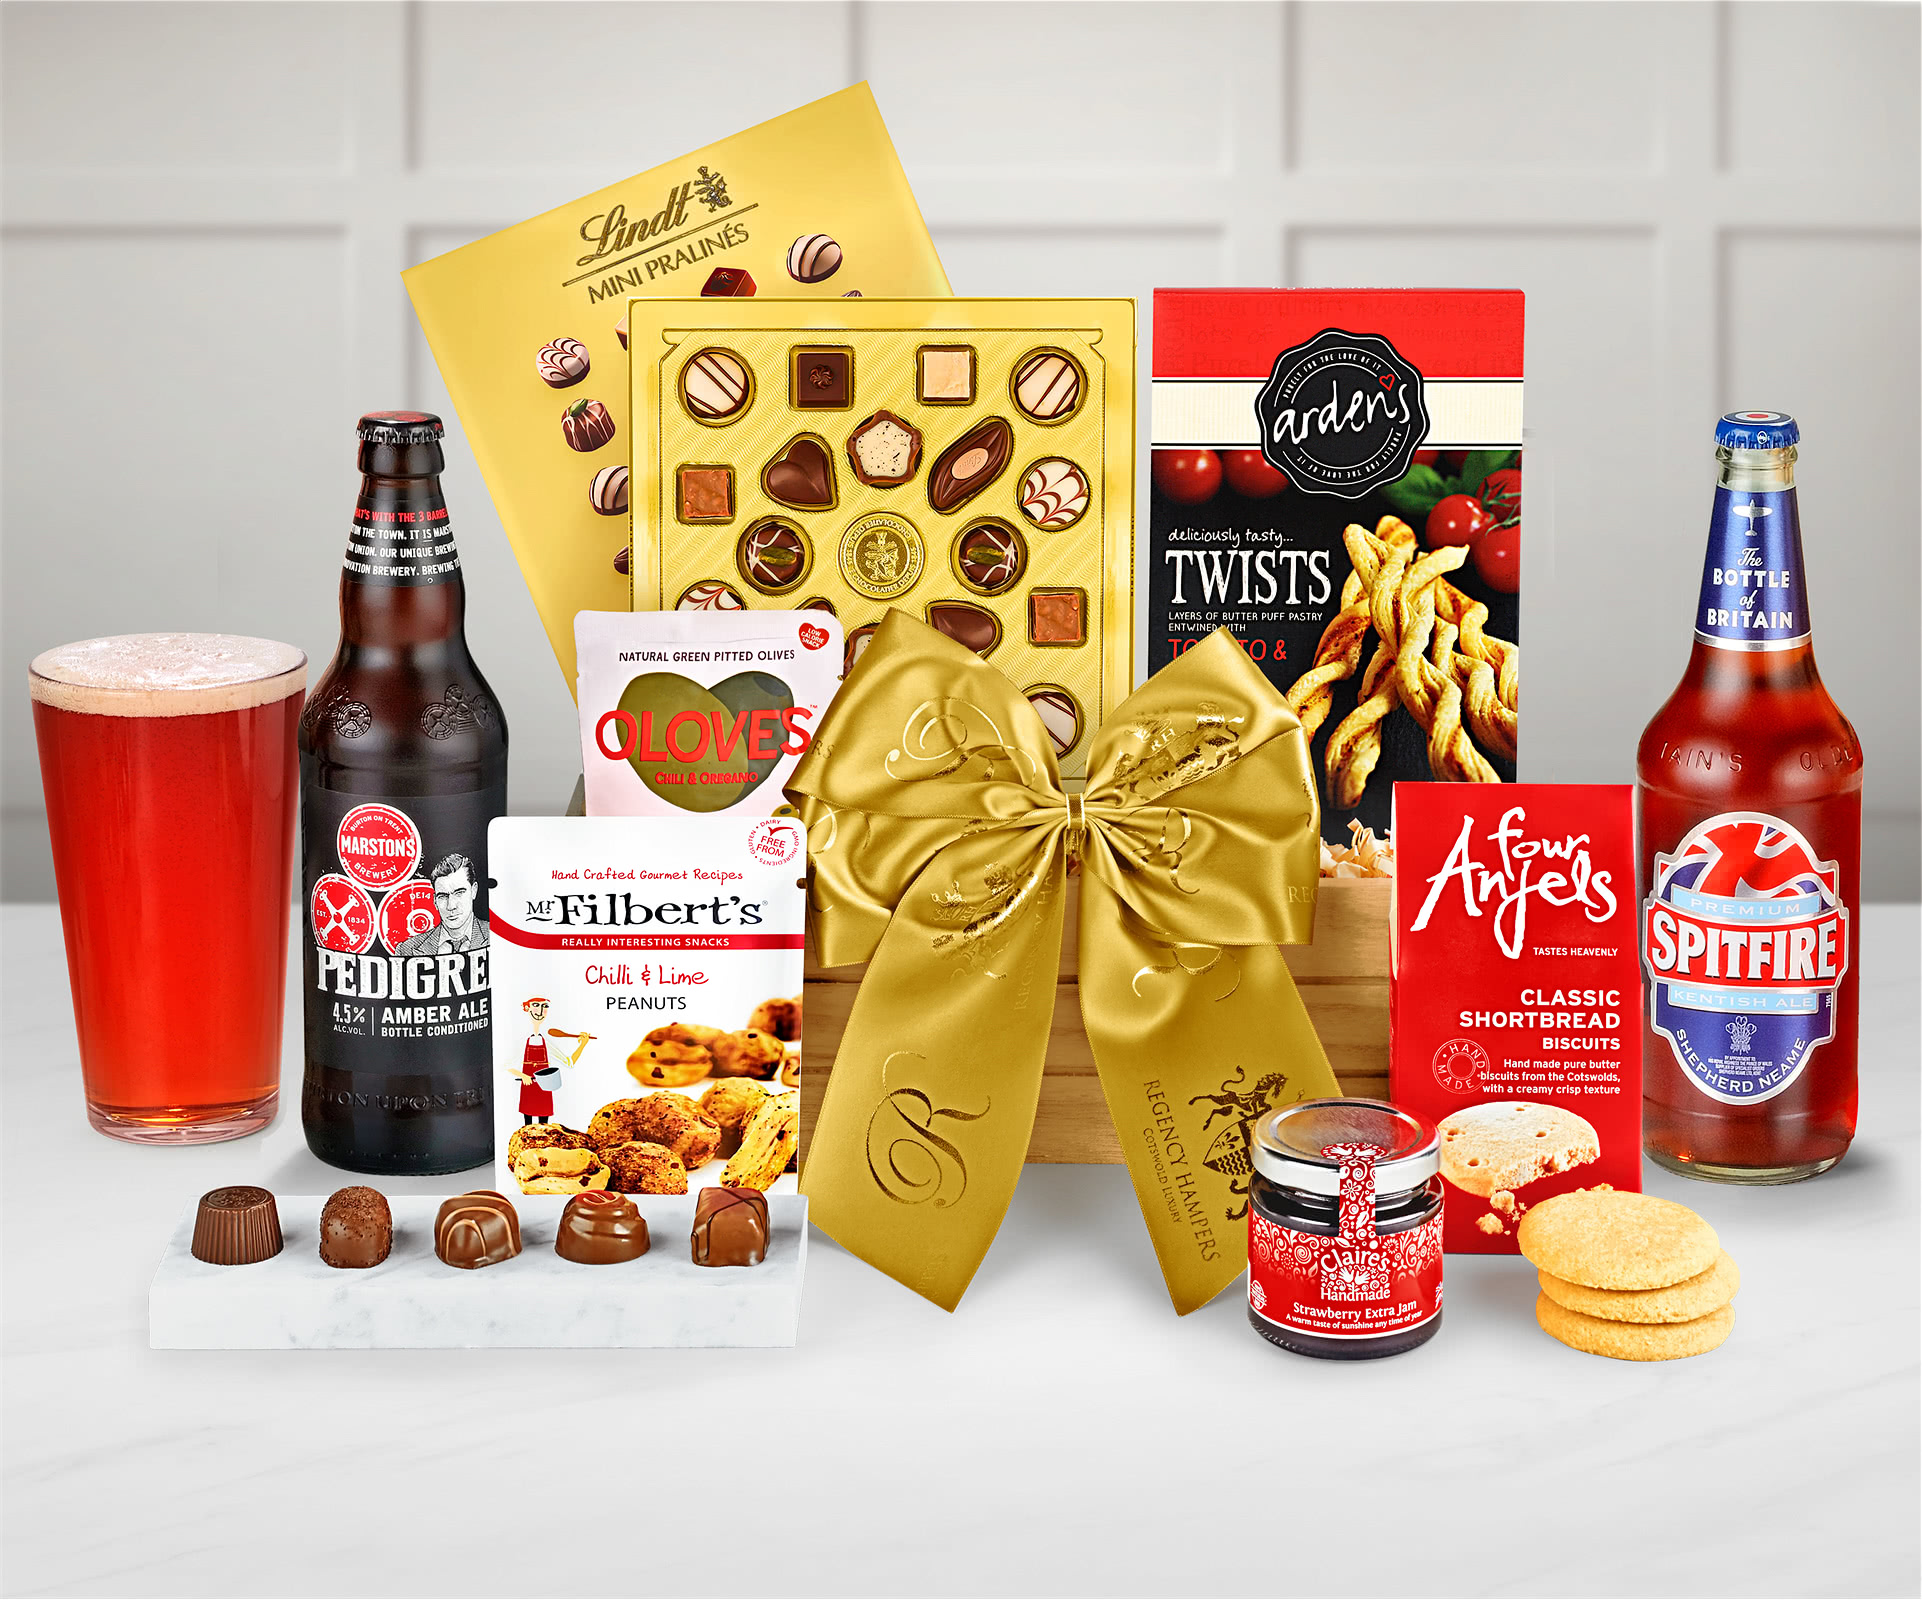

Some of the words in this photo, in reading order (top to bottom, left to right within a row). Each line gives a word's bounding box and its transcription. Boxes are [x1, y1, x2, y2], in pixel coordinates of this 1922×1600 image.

[576, 181, 695, 267] Lindt
[588, 268, 644, 304] MINI
[645, 223, 749, 281] PRALINÉS
[372, 512, 395, 522] WITH
[398, 513, 416, 522] THE
[419, 511, 424, 522] 3
[362, 527, 375, 538] THE
[379, 530, 407, 540] TOWN.
[410, 530, 419, 539] IT
[423, 529, 432, 539] IS
[1168, 528, 1240, 548] deliciously
[380, 548, 397, 558] OUR
[400, 547, 433, 558] UNIQUE
[1737, 548, 1763, 566] The
[373, 566, 419, 576] BREWERY.
[422, 561, 454, 575] BREWING
[1165, 550, 1332, 605] TWISTS
[1713, 568, 1790, 588] BOTTLE
[1739, 590, 1758, 609] of
[1169, 612, 1202, 621] LAYERS
[1206, 612, 1218, 621] OF
[1223, 612, 1258, 621] BUTTER
[1262, 612, 1285, 621] PUFF
[1289, 612, 1323, 621] PASTRY
[1707, 608, 1793, 629] BRITAIN
[808, 628, 821, 636] LOW
[1169, 623, 1217, 632] ENTWINED
[802, 638, 820, 648] SNACK
[1273, 640, 1287, 660] &
[619, 650, 669, 662] NATURAL
[673, 652, 710, 662] GREEN
[714, 650, 753, 661] PITTED
[758, 649, 795, 661] OLIVES
[596, 707, 814, 763] OLOVES
[688, 772, 697, 785] &
[350, 815, 372, 832] BURTON
[385, 817, 403, 834] TRENT
[341, 835, 415, 857] MARSTON'S
[756, 844, 784, 857] FROM
[761, 836, 786, 848] FREE
[1488, 806, 1590, 881] four
[354, 862, 398, 879] BREWERY
[552, 869, 578, 880] Hand
[584, 869, 635, 880] Crafted
[640, 869, 688, 881] Gourmet
[693, 869, 743, 885] Recipes
[554, 892, 763, 926] Filbert's
[1690, 898, 1800, 915] PREMIUM
[348, 916, 365, 924] 1834
[562, 938, 602, 947] REALLY
[607, 938, 681, 947] INTERESTING
[685, 938, 729, 947] SNACKS
[1533, 947, 1568, 956] TASTES
[1570, 947, 1618, 957] HEAVENLY
[1652, 910, 1837, 980] SPITFIRE
[316, 947, 491, 1000] PEDIGRE
[585, 964, 633, 985] Chilli
[641, 964, 651, 986] &
[659, 965, 709, 985] Lime
[606, 996, 686, 1010] PEANUTS
[1520, 989, 1620, 1007] CLASSIC
[1674, 989, 1767, 1008] KENTISH
[1776, 997, 1813, 1007] ALE
[333, 1002, 366, 1023] 4.5%
[381, 1005, 451, 1024] AMBER
[458, 998, 488, 1020] ALE
[1459, 1011, 1620, 1029] SHORTBREAD
[381, 1027, 422, 1037] BOTTLE
[427, 1018, 488, 1036] CONDITIONED
[1543, 1037, 1620, 1050] BISCUITS
[1450, 1044, 1486, 1070] HAND
[1504, 1059, 1530, 1069] Hand
[1533, 1059, 1560, 1069] made
[1564, 1061, 1586, 1071] pure
[1589, 1059, 1620, 1069] butter
[1676, 1028, 1754, 1093] SHEPHERD
[1759, 1037, 1806, 1089] NEAME
[1437, 1064, 1474, 1090] MADE
[1480, 1071, 1519, 1081] biscuits
[1522, 1071, 1546, 1081] from
[1548, 1072, 1564, 1081] the
[1567, 1072, 1621, 1083] Cotswolds,
[1482, 1084, 1504, 1093] with
[1516, 1085, 1553, 1096] creamy
[1556, 1085, 1581, 1095] crisp
[1584, 1085, 1620, 1095] texture
[1143, 1079, 1189, 1167] REGENCY
[1176, 1172, 1221, 1262] HAMPERS
[1143, 1127, 1169, 1184] COTSWOLD
[1162, 1186, 1183, 1224] LUXURY
[1321, 1248, 1390, 1273] Claire's
[1321, 1286, 1390, 1302] Handmade
[1292, 1316, 1311, 1326] warm
[1313, 1320, 1331, 1328] taste
[1333, 1321, 1340, 1329] of
[1342, 1322, 1373, 1330] sunshine
[1375, 1321, 1387, 1329] any
[1389, 1317, 1402, 1326] time
[1404, 1313, 1411, 1322] of
[1410, 1310, 1423, 1321] year
[1293, 1302, 1361, 1322] Strawberry
[1365, 1306, 1395, 1319] Extra
[1397, 1301, 1417, 1317] Jam
